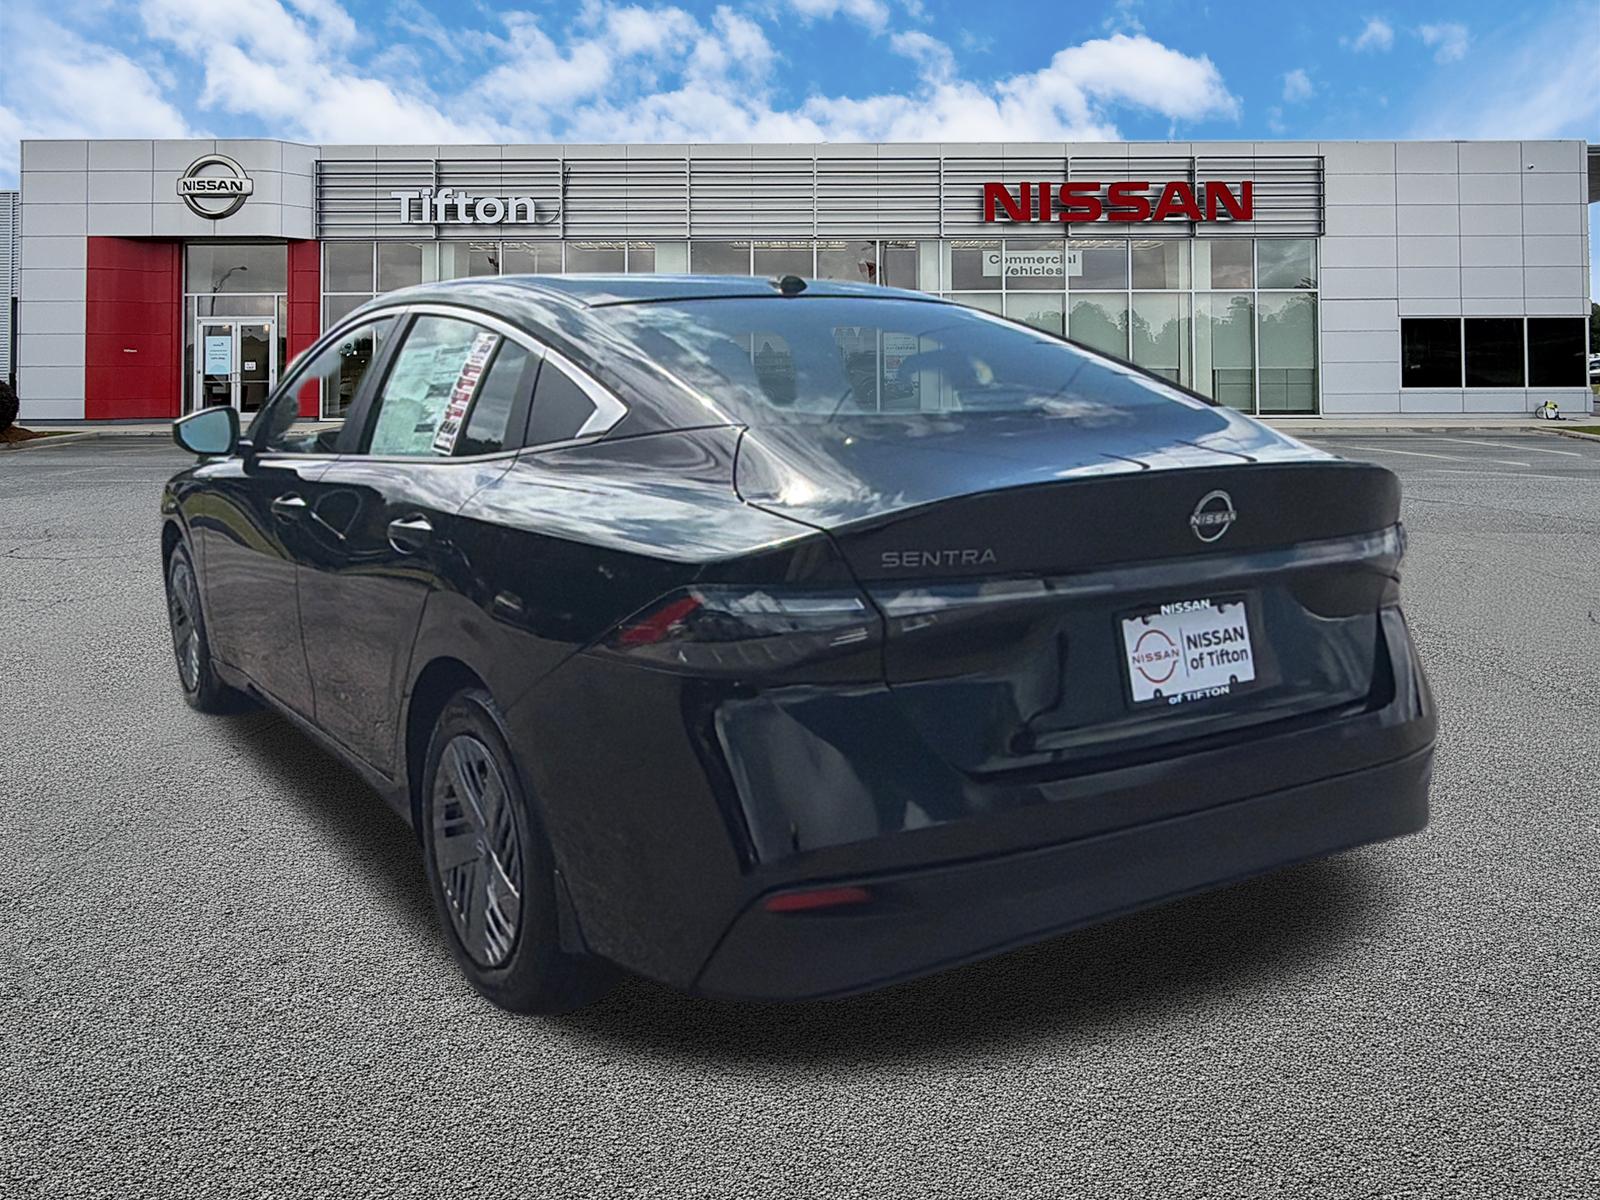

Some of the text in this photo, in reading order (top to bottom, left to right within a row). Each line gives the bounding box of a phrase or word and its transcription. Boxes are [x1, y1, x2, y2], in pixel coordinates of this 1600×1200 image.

[182, 180, 243, 191] NISSAN
[391, 188, 536, 224] Tifton
[982, 181, 1253, 222] NISSAN
[1190, 510, 1237, 526] NISSAN
[881, 548, 997, 568] SENTRA
[1160, 599, 1211, 616] NISSAN
[1186, 626, 1246, 650] NISSAN
[1131, 648, 1180, 665] NISSAN
[1190, 648, 1249, 670] of Tifton
[1168, 685, 1230, 705] of TIFTON
